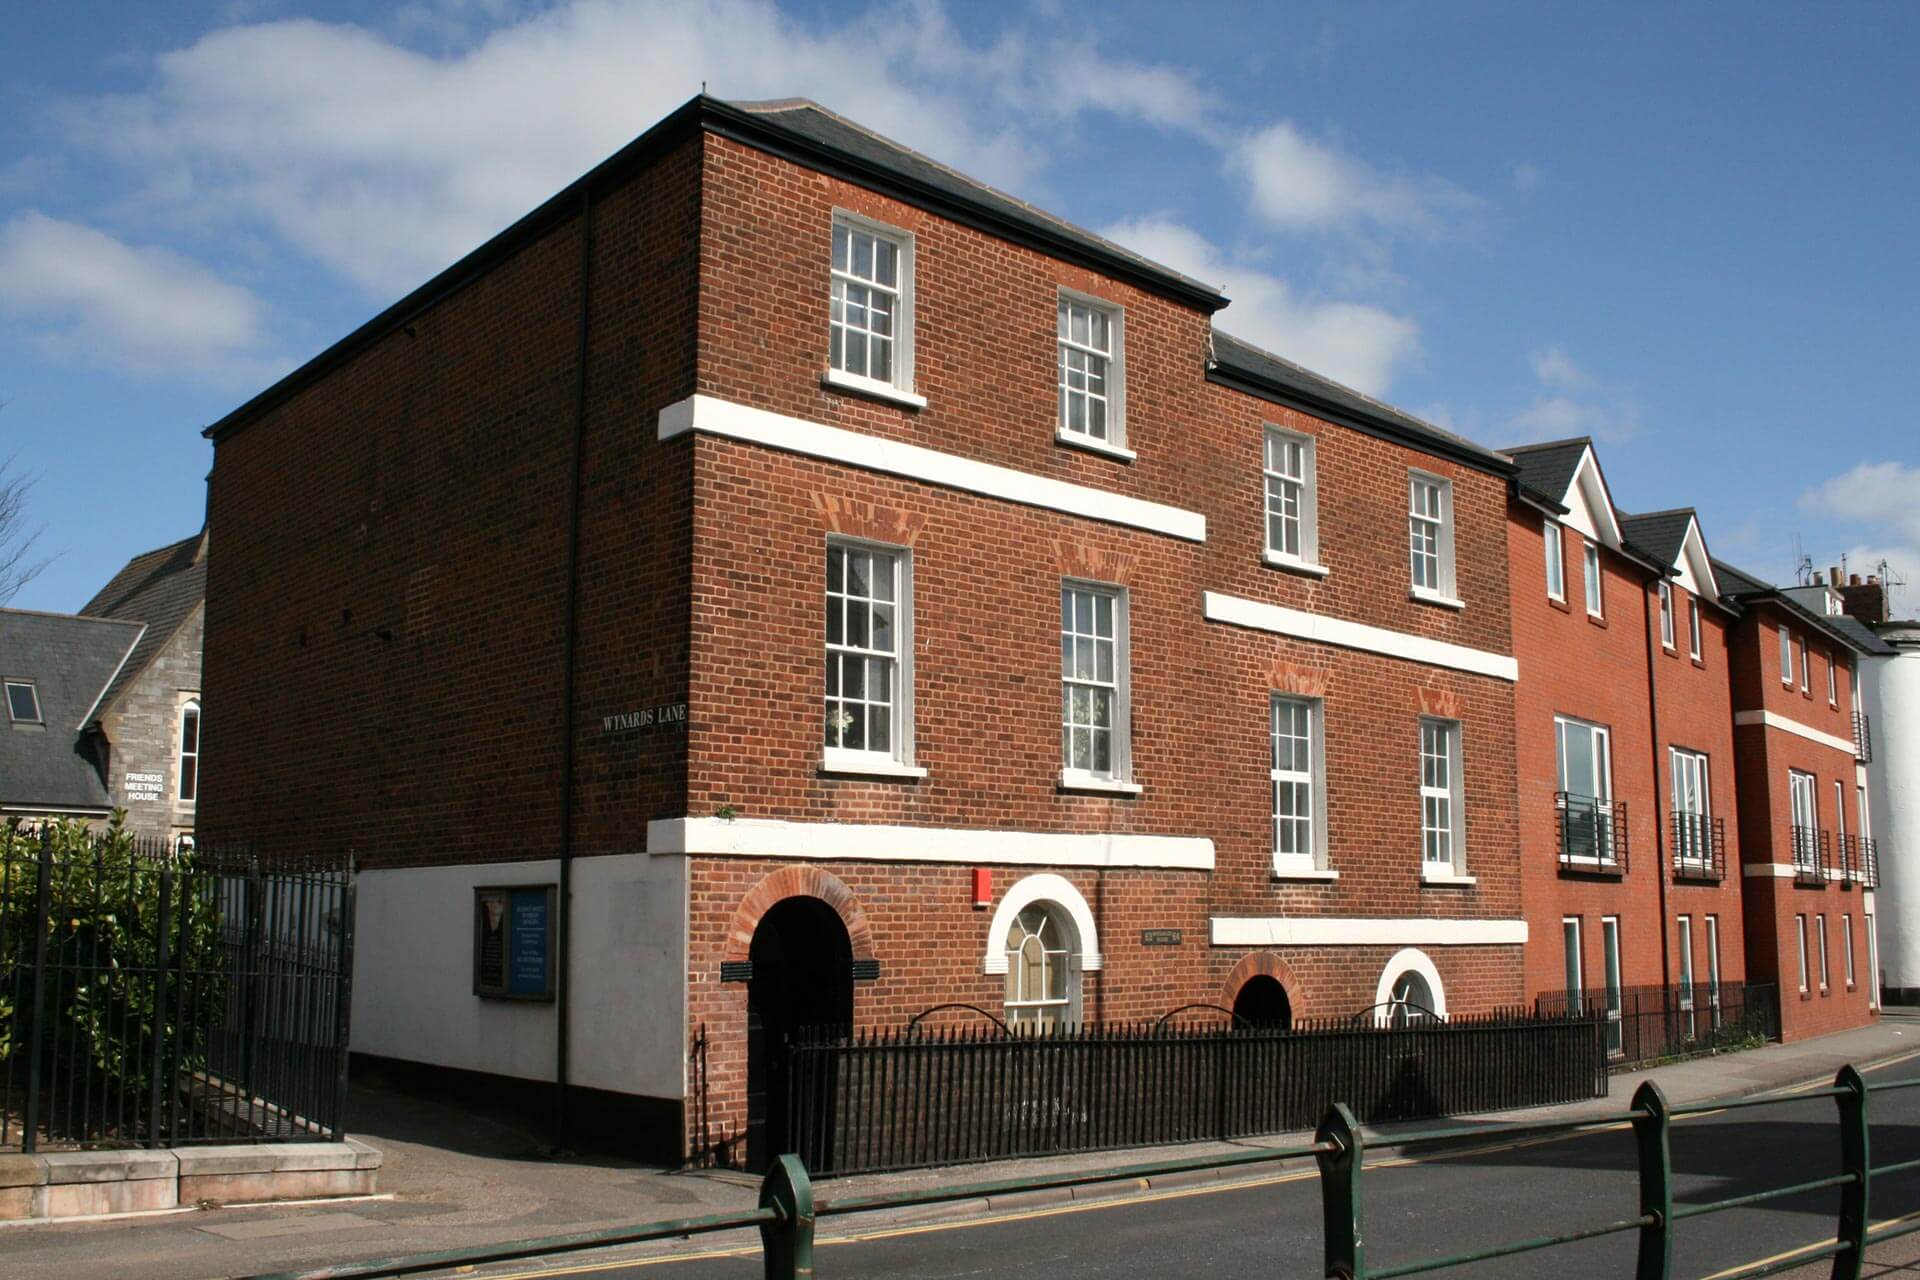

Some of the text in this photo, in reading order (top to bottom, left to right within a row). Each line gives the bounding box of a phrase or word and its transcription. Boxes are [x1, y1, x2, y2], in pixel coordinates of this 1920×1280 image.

[603, 704, 686, 731] WYNARDS LANE
[126, 773, 163, 782] FRIENDS
[124, 782, 163, 792] MEETING
[128, 792, 159, 801] HOUSE
